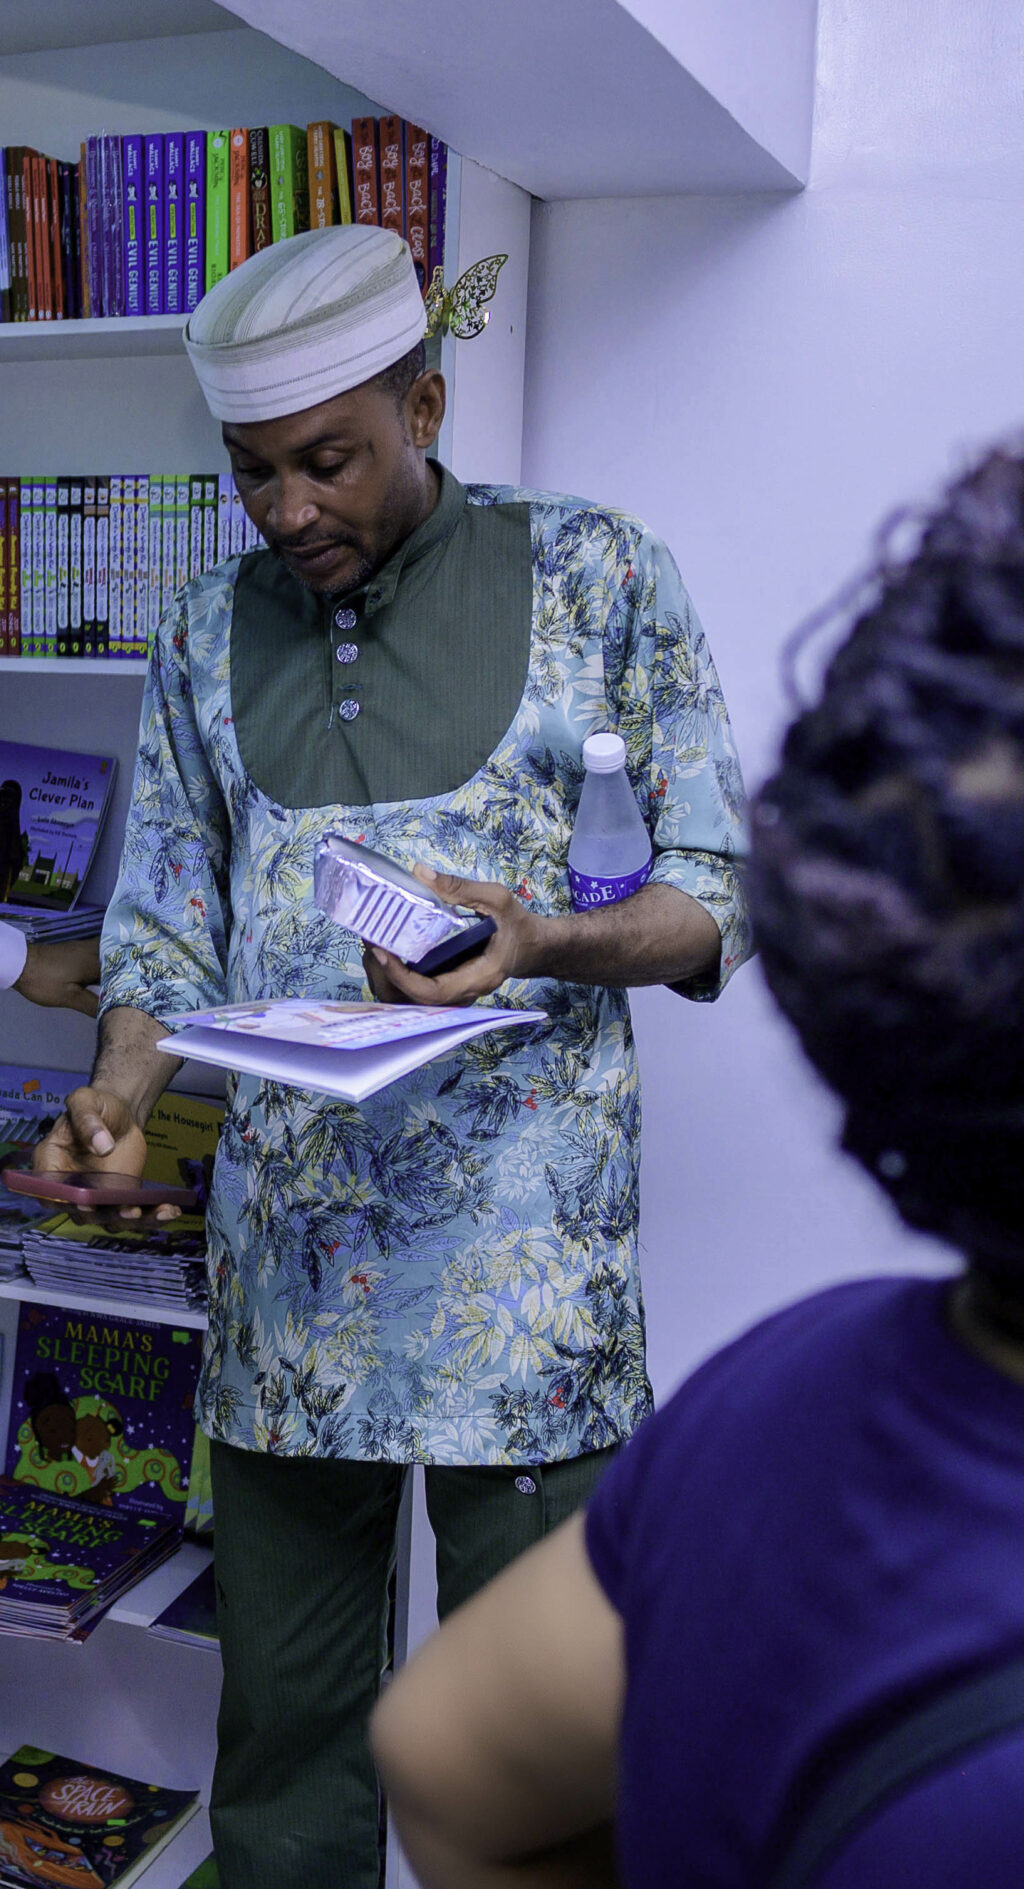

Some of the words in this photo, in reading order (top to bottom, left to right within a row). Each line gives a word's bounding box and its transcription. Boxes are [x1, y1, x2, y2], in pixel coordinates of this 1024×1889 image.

[127, 242, 138, 267] EVIL
[148, 241, 158, 267] EVIL
[167, 240, 178, 266] EVIL
[187, 238, 198, 265] EVIL
[42, 771, 89, 791] Jamila's
[29, 787, 66, 805] Clever
[69, 794, 95, 810] Plan
[46, 1092, 60, 1104] Do
[158, 1109, 170, 1121] the
[174, 1112, 213, 1133] Housegirl
[64, 1321, 152, 1352] MAMA'S
[36, 1335, 170, 1380] SLEEPING
[79, 1367, 164, 1402] SCARF
